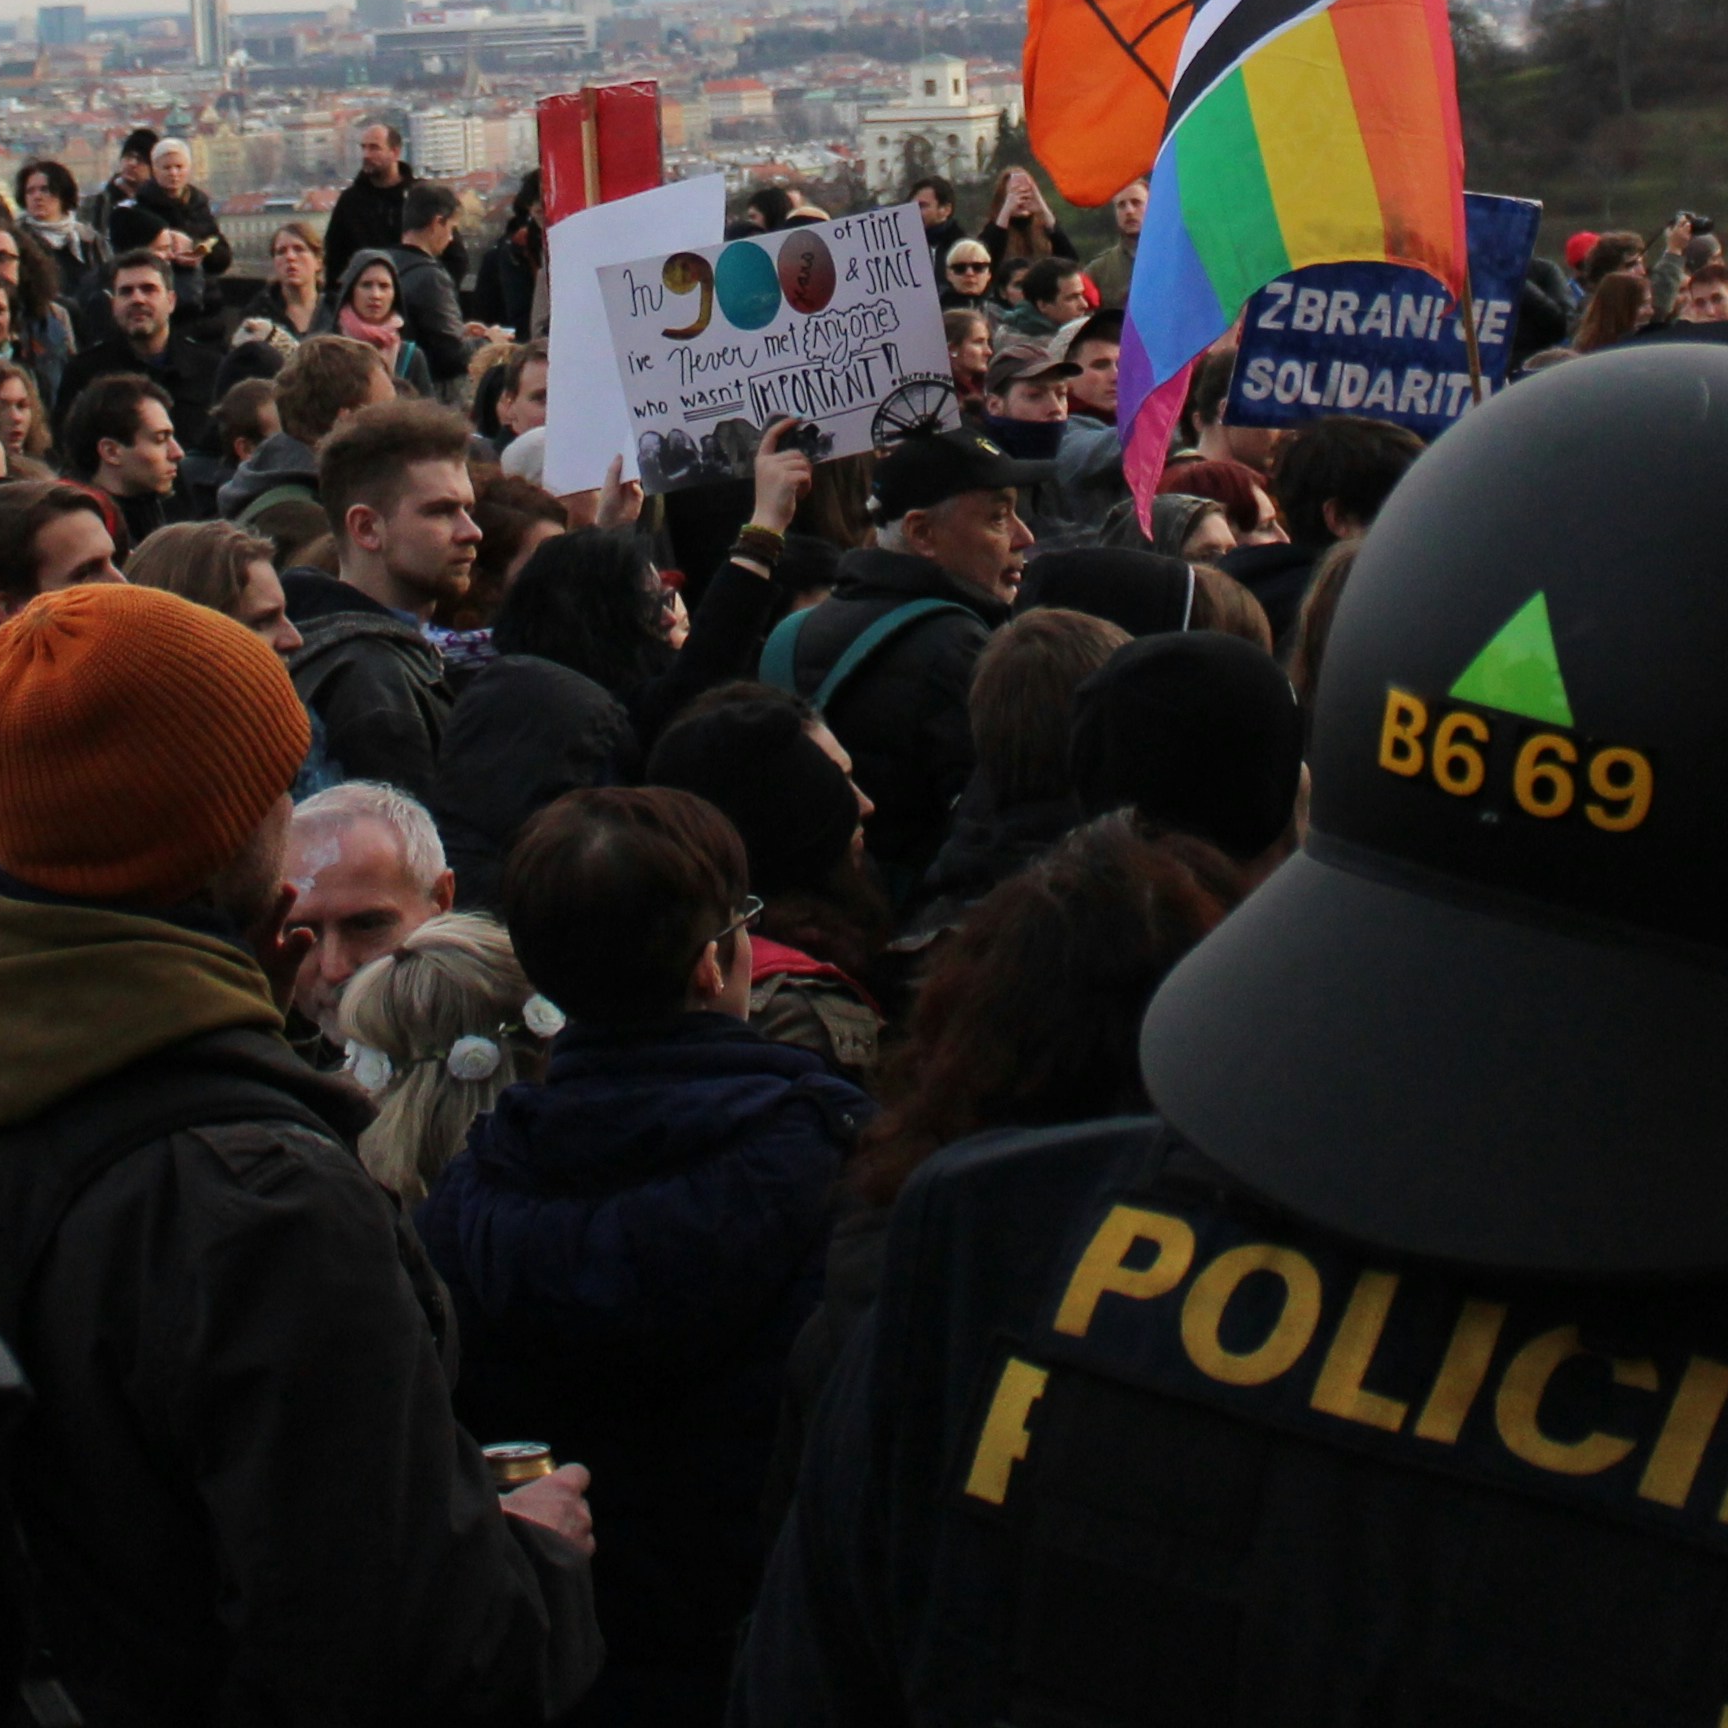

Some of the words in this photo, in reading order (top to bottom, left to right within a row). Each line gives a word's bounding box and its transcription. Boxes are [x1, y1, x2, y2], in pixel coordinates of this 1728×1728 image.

[865, 248, 922, 295] SPACE
[763, 321, 799, 359] met
[633, 399, 669, 419] who
